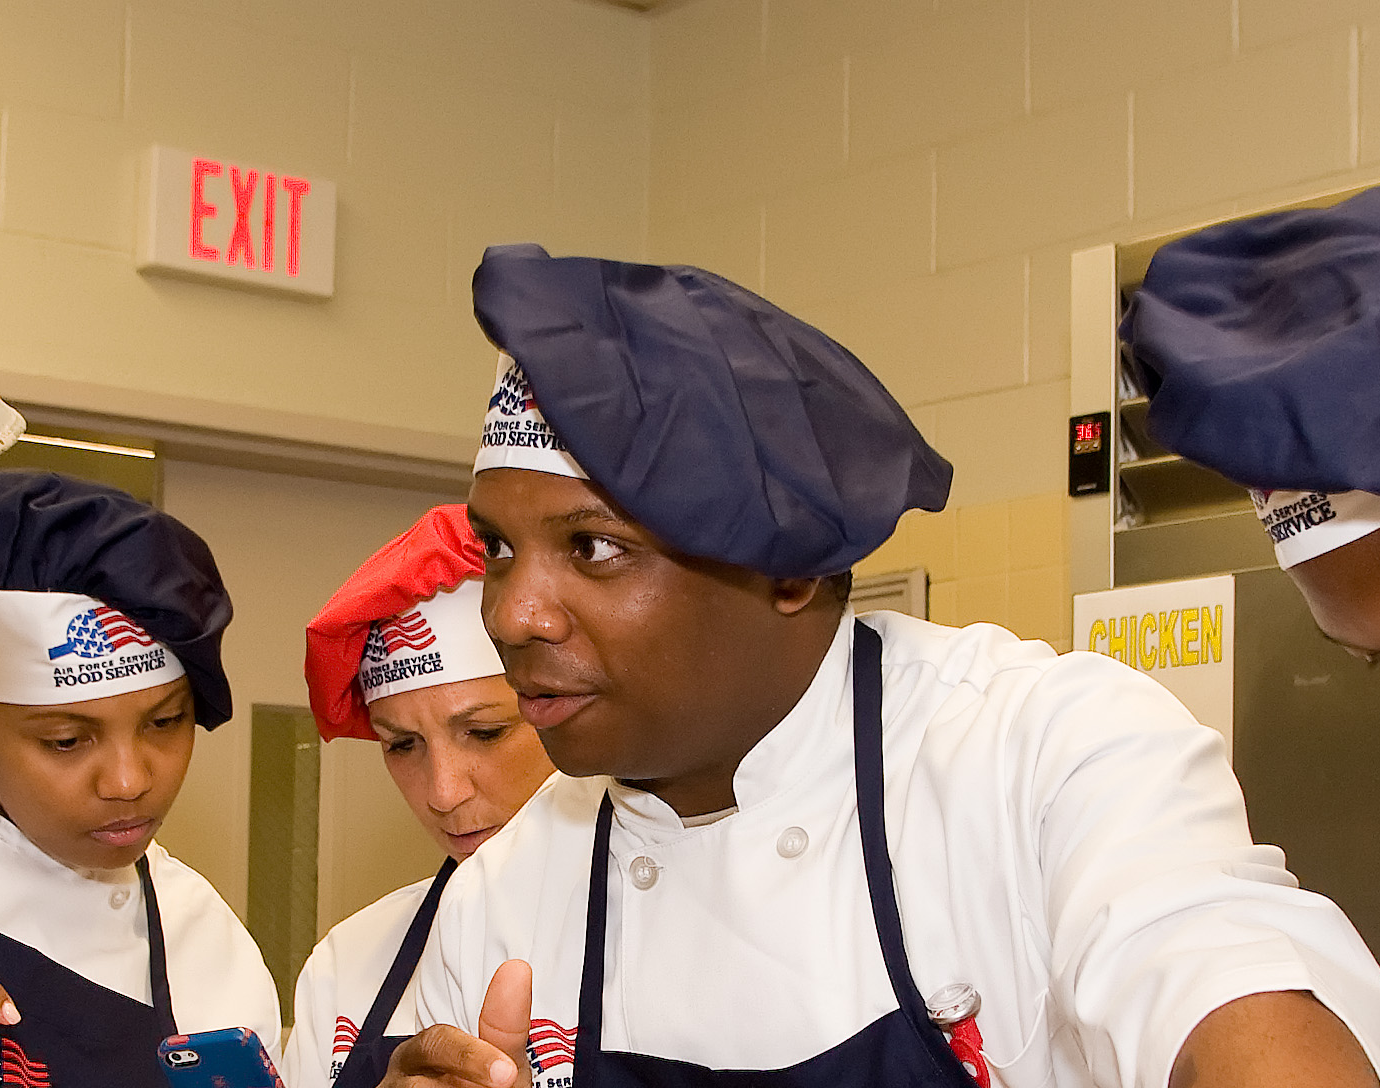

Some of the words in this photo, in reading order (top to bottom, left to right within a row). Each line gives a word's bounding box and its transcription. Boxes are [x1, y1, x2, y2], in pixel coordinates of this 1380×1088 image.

[187, 156, 312, 278] EXIT
[1088, 604, 1223, 672] CHICKEN
[53, 667, 74, 676] AIR
[79, 660, 114, 673] FORCE
[119, 648, 165, 665] SERVICES
[53, 671, 104, 688] FOOD
[105, 656, 166, 681] SERVICE
[384, 659, 444, 684] SERVICE
[392, 651, 441, 668] SERVICES
